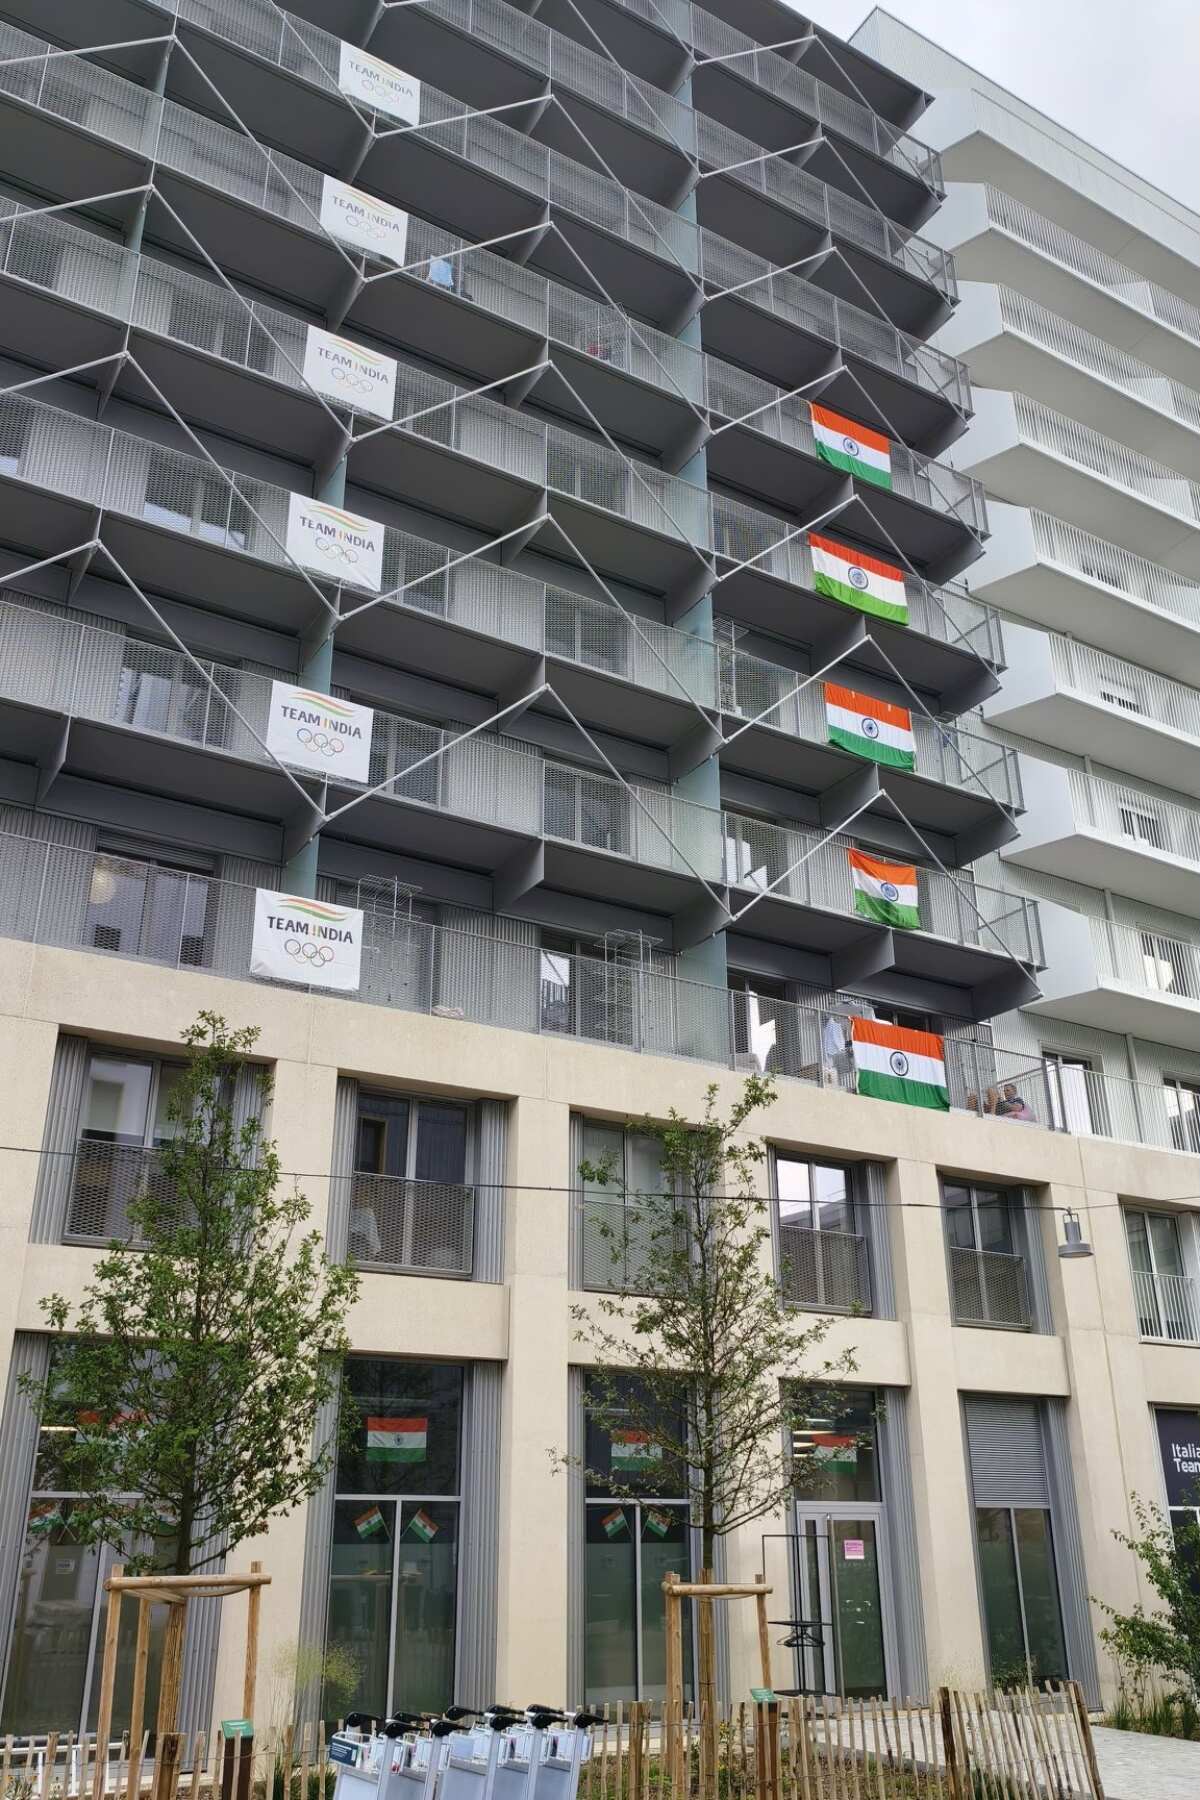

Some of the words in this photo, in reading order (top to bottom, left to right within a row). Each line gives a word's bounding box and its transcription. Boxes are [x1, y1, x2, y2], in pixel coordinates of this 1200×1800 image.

[332, 195, 365, 217] TEAM
[367, 211, 400, 233] INDIA
[317, 346, 352, 369] TEAM
[353, 361, 389, 385] INDIA
[299, 515, 337, 539] TEAM
[338, 528, 375, 552] INDIA
[281, 704, 321, 727] TEAM
[323, 717, 362, 740] INDIA
[267, 915, 309, 936] TEAM
[312, 924, 354, 944] INDIA
